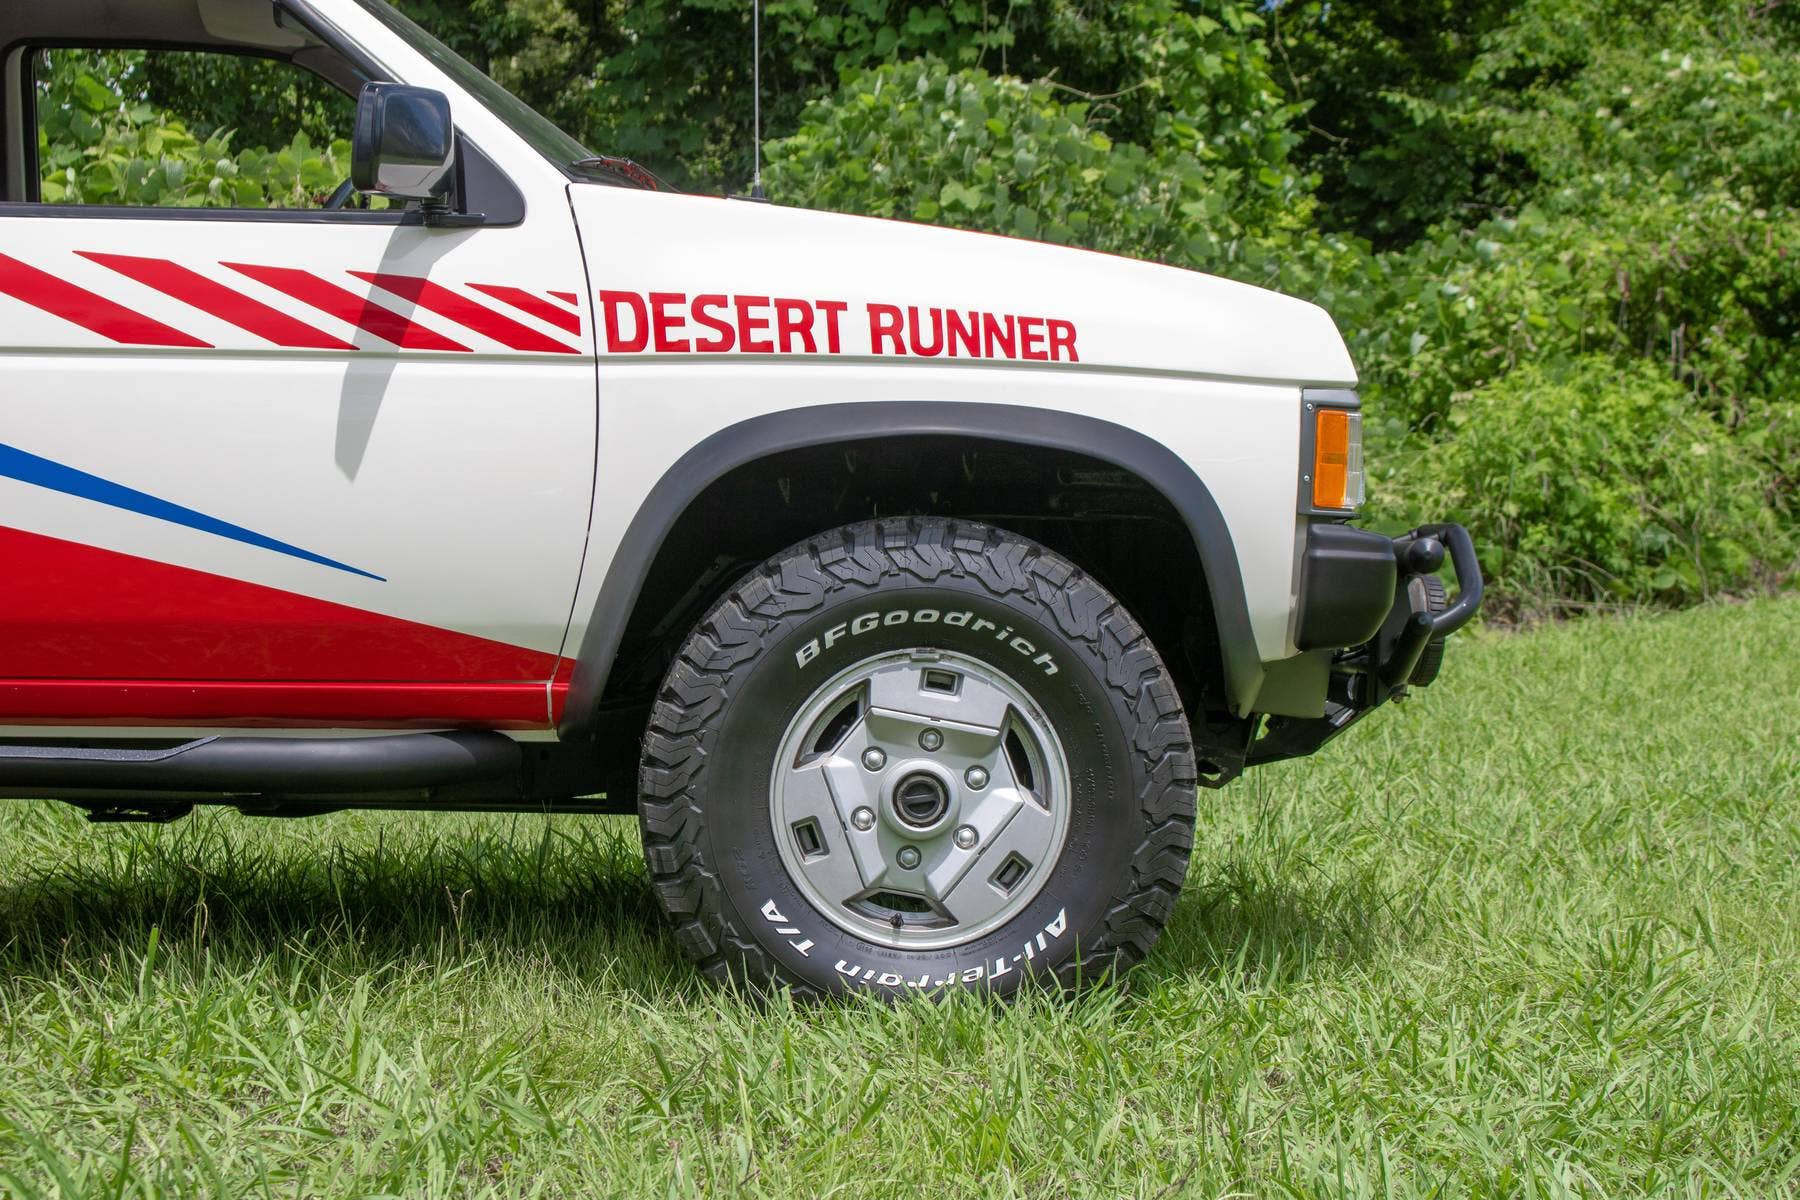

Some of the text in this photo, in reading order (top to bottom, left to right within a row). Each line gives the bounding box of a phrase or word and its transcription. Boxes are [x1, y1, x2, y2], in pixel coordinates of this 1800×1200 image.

[599, 290, 1079, 362] DESERT RUNNER
[795, 608, 1059, 676] BFGoodrich
[761, 898, 815, 957] T/A
[834, 907, 1067, 988] All-Terrain
